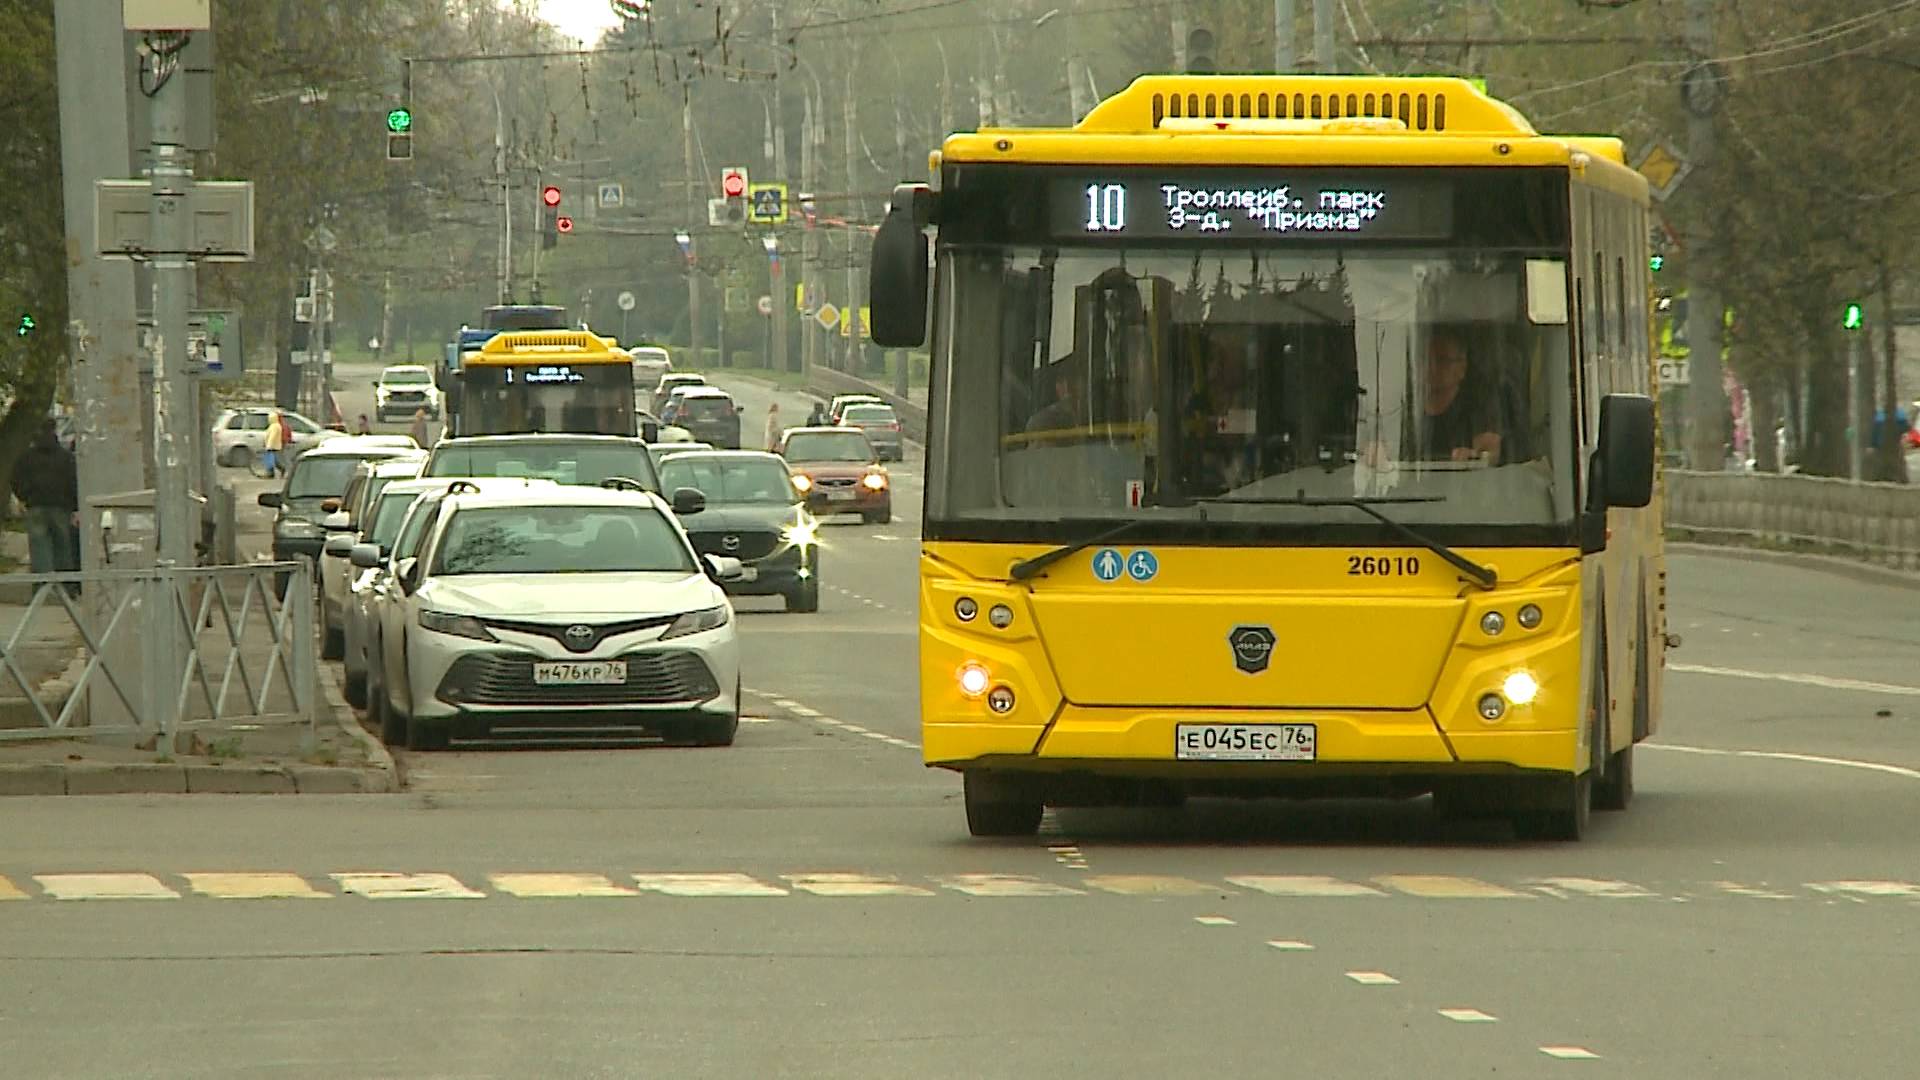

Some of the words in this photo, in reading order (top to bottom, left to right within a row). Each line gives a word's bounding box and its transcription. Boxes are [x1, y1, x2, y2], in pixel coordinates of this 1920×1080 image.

[1086, 183, 1126, 231] 10
[1161, 184, 1302, 208] Троллейб.
[1319, 189, 1385, 209] парк
[1660, 363, 1687, 379] СТ
[1347, 557, 1420, 577] 26010
[606, 663, 622, 675] 76
[1187, 727, 1278, 750] Е045ЕС
[1284, 727, 1306, 745] 76
